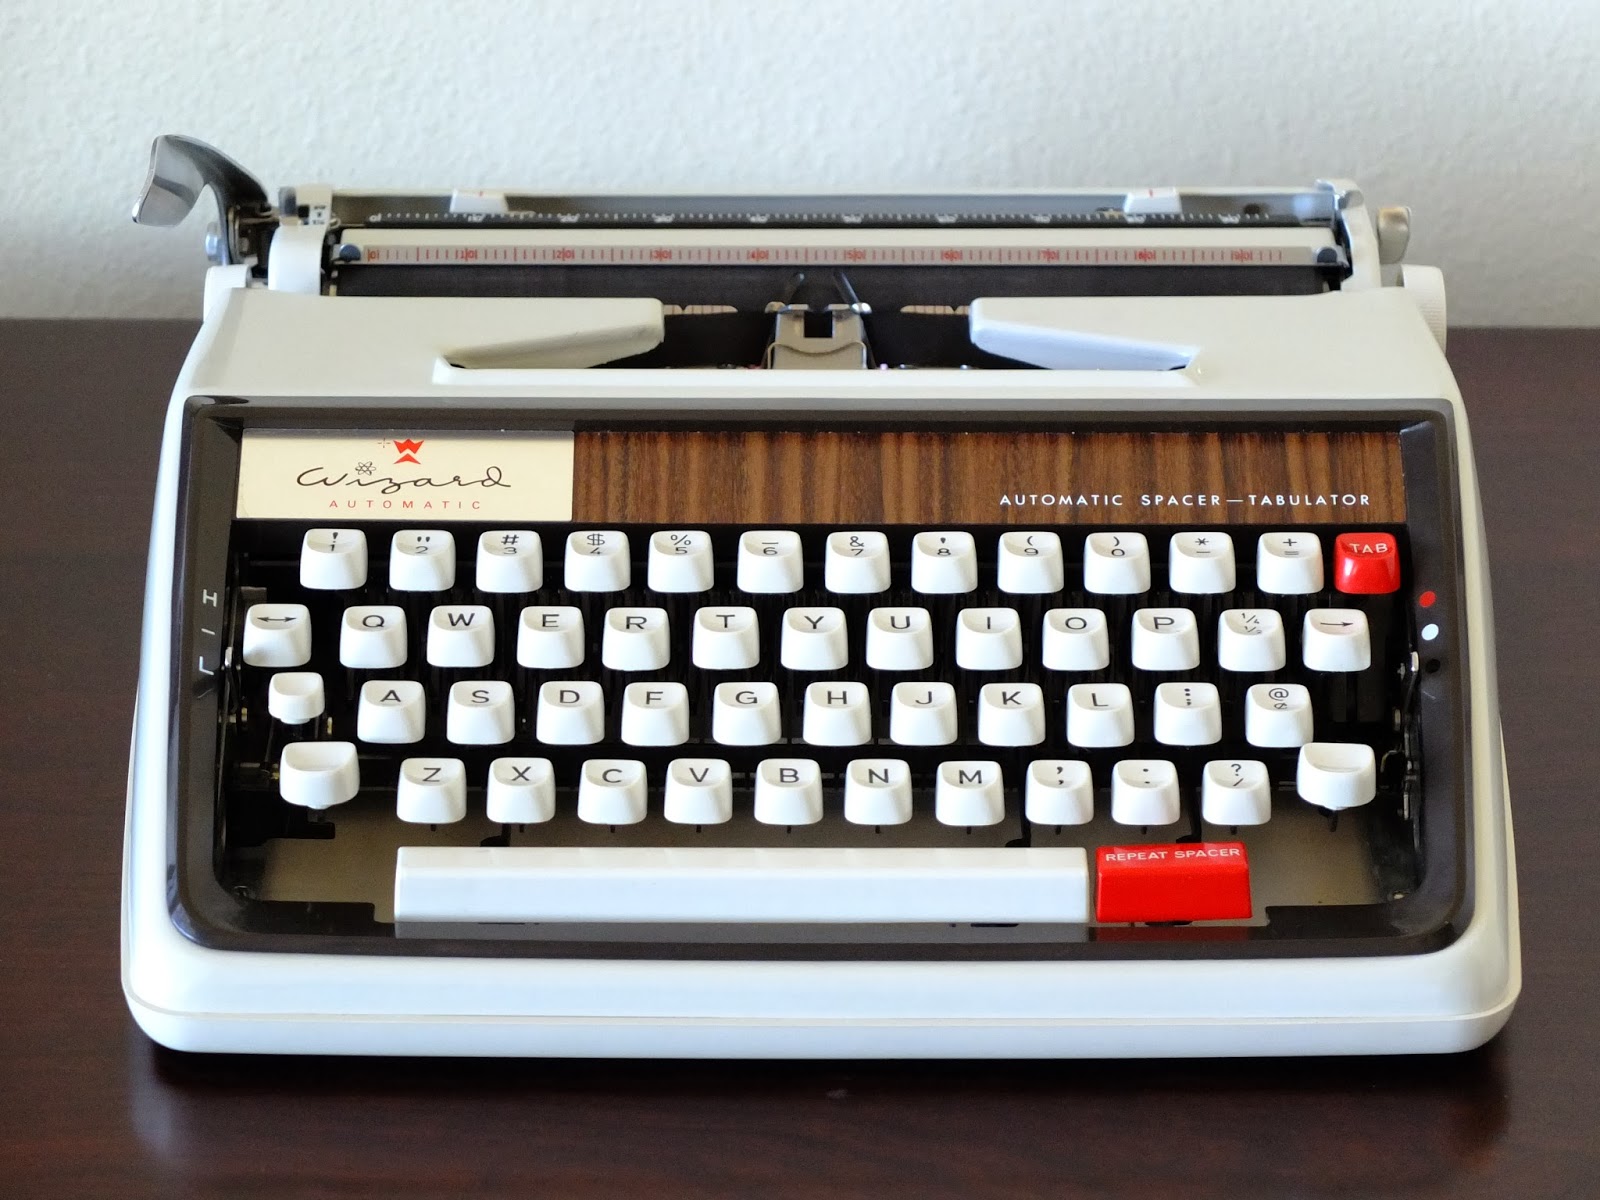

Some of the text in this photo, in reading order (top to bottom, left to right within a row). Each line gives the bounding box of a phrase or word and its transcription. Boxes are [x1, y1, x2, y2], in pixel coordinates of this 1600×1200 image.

[556, 249, 571, 260] 20
[654, 249, 669, 260] 30
[329, 500, 481, 510] AUTOMATIC
[999, 494, 1123, 506] AUTOMATIC
[500, 534, 520, 546] #
[586, 533, 606, 547] $
[670, 534, 692, 546] %
[849, 535, 865, 548] &
[415, 545, 429, 555] 2
[503, 546, 518, 555] 3
[589, 546, 602, 555] 4
[675, 546, 688, 555] 5
[762, 546, 778, 556] 6
[850, 548, 864, 557] 7
[936, 547, 952, 556] 8
[1023, 547, 1039, 556] 9
[1349, 542, 1389, 555] TAB
[361, 614, 385, 628] Q
[447, 612, 475, 627] W
[541, 613, 560, 628] E
[625, 615, 648, 630] R
[715, 614, 736, 629] T
[804, 615, 824, 630] Y
[890, 615, 911, 630] U
[1153, 616, 1175, 631] P
[379, 689, 402, 703] A
[471, 689, 490, 704] S
[559, 689, 581, 704] D
[645, 690, 664, 705] F
[735, 690, 758, 705] G
[827, 690, 848, 705] H
[915, 690, 933, 705] J
[1001, 691, 1022, 706] K
[1091, 692, 1109, 707] L
[1268, 687, 1290, 702] @
[421, 767, 442, 783] Z
[511, 766, 532, 782] X
[601, 768, 623, 784] C
[688, 767, 710, 783] V
[779, 767, 800, 784] B
[868, 768, 889, 784] N
[958, 769, 983, 785] M
[1230, 763, 1242, 777] ?
[1105, 848, 1241, 862] REPEAT SPACER
